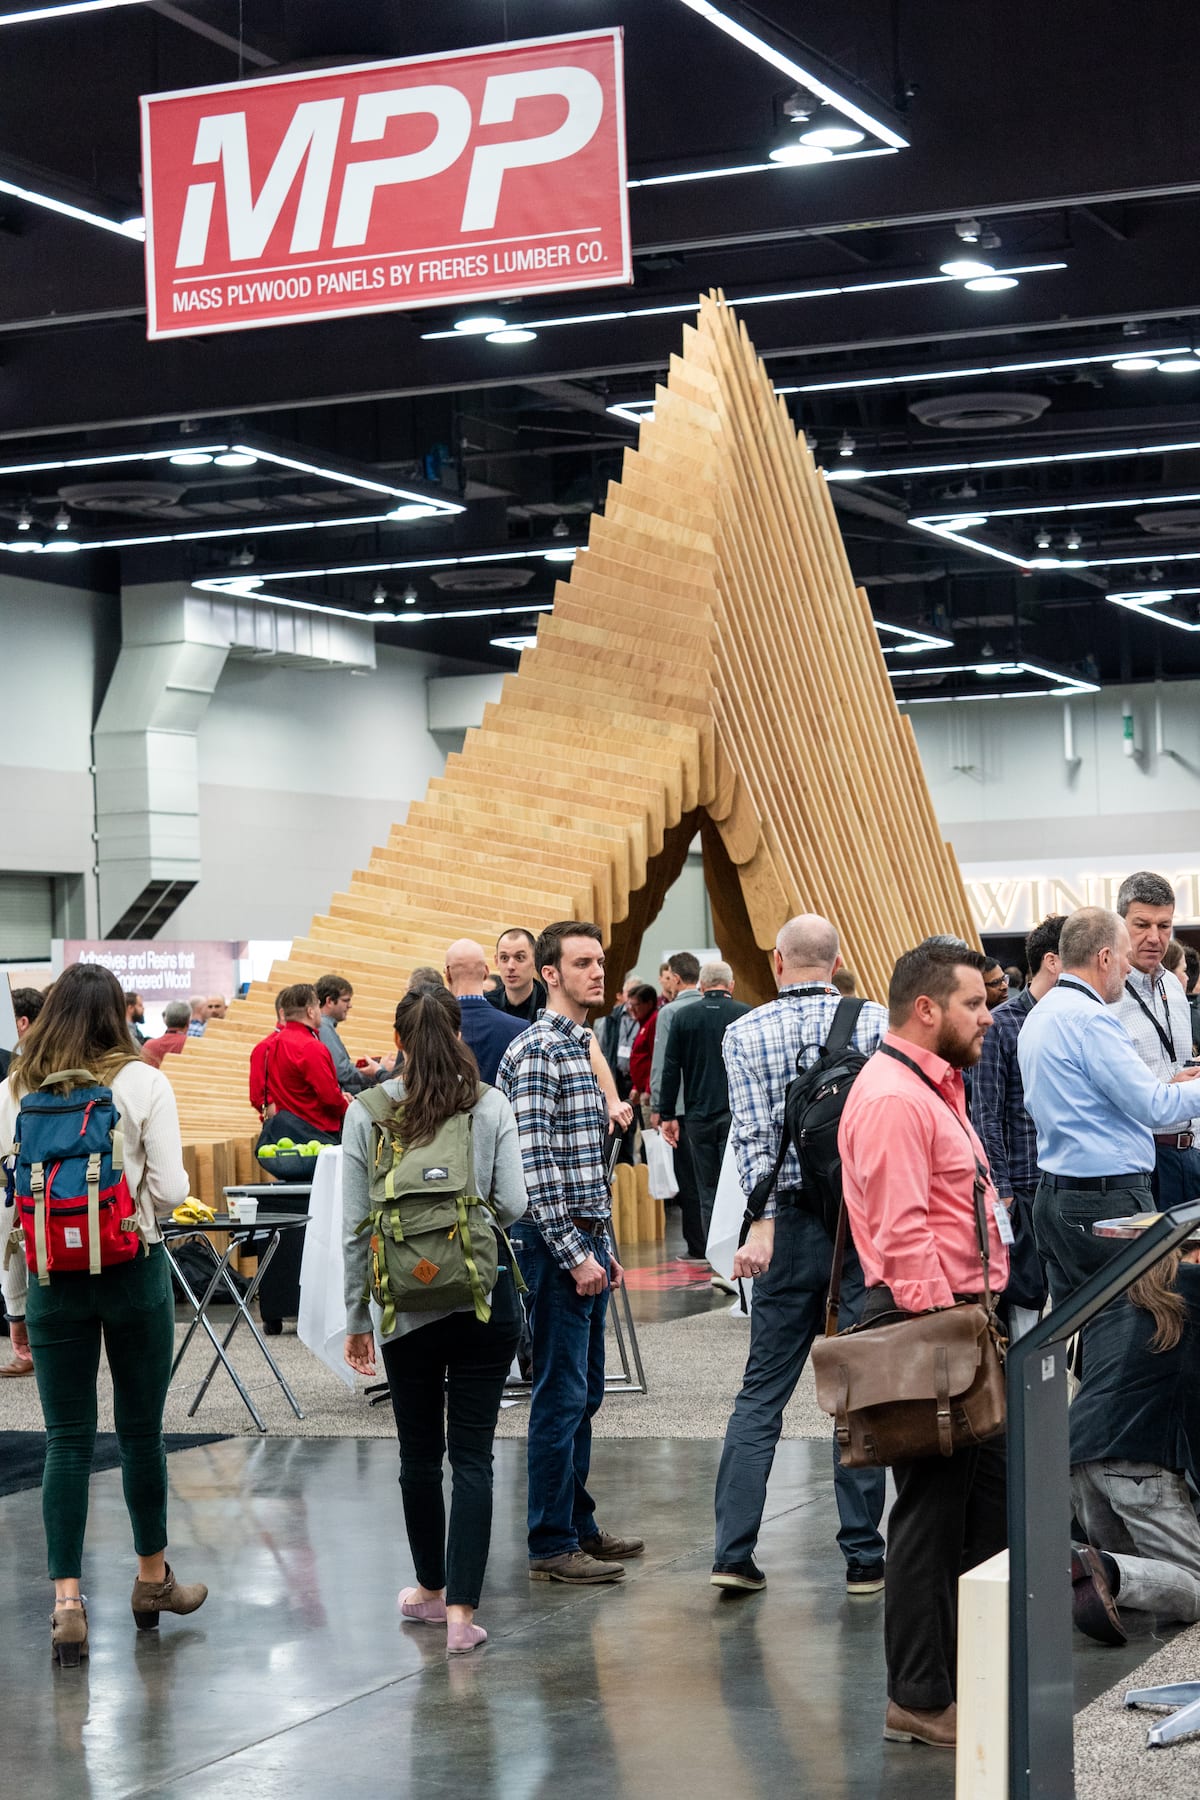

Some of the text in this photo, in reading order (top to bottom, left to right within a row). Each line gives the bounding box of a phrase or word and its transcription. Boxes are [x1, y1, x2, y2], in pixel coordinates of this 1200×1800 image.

[174, 66, 604, 268] MPP
[172, 240, 609, 313] MASS PLYWOOD PANELS BY FRERES LUMBER CO.
[78, 950, 196, 970] Adhesives and Resins that
[164, 970, 192, 989] Wood
